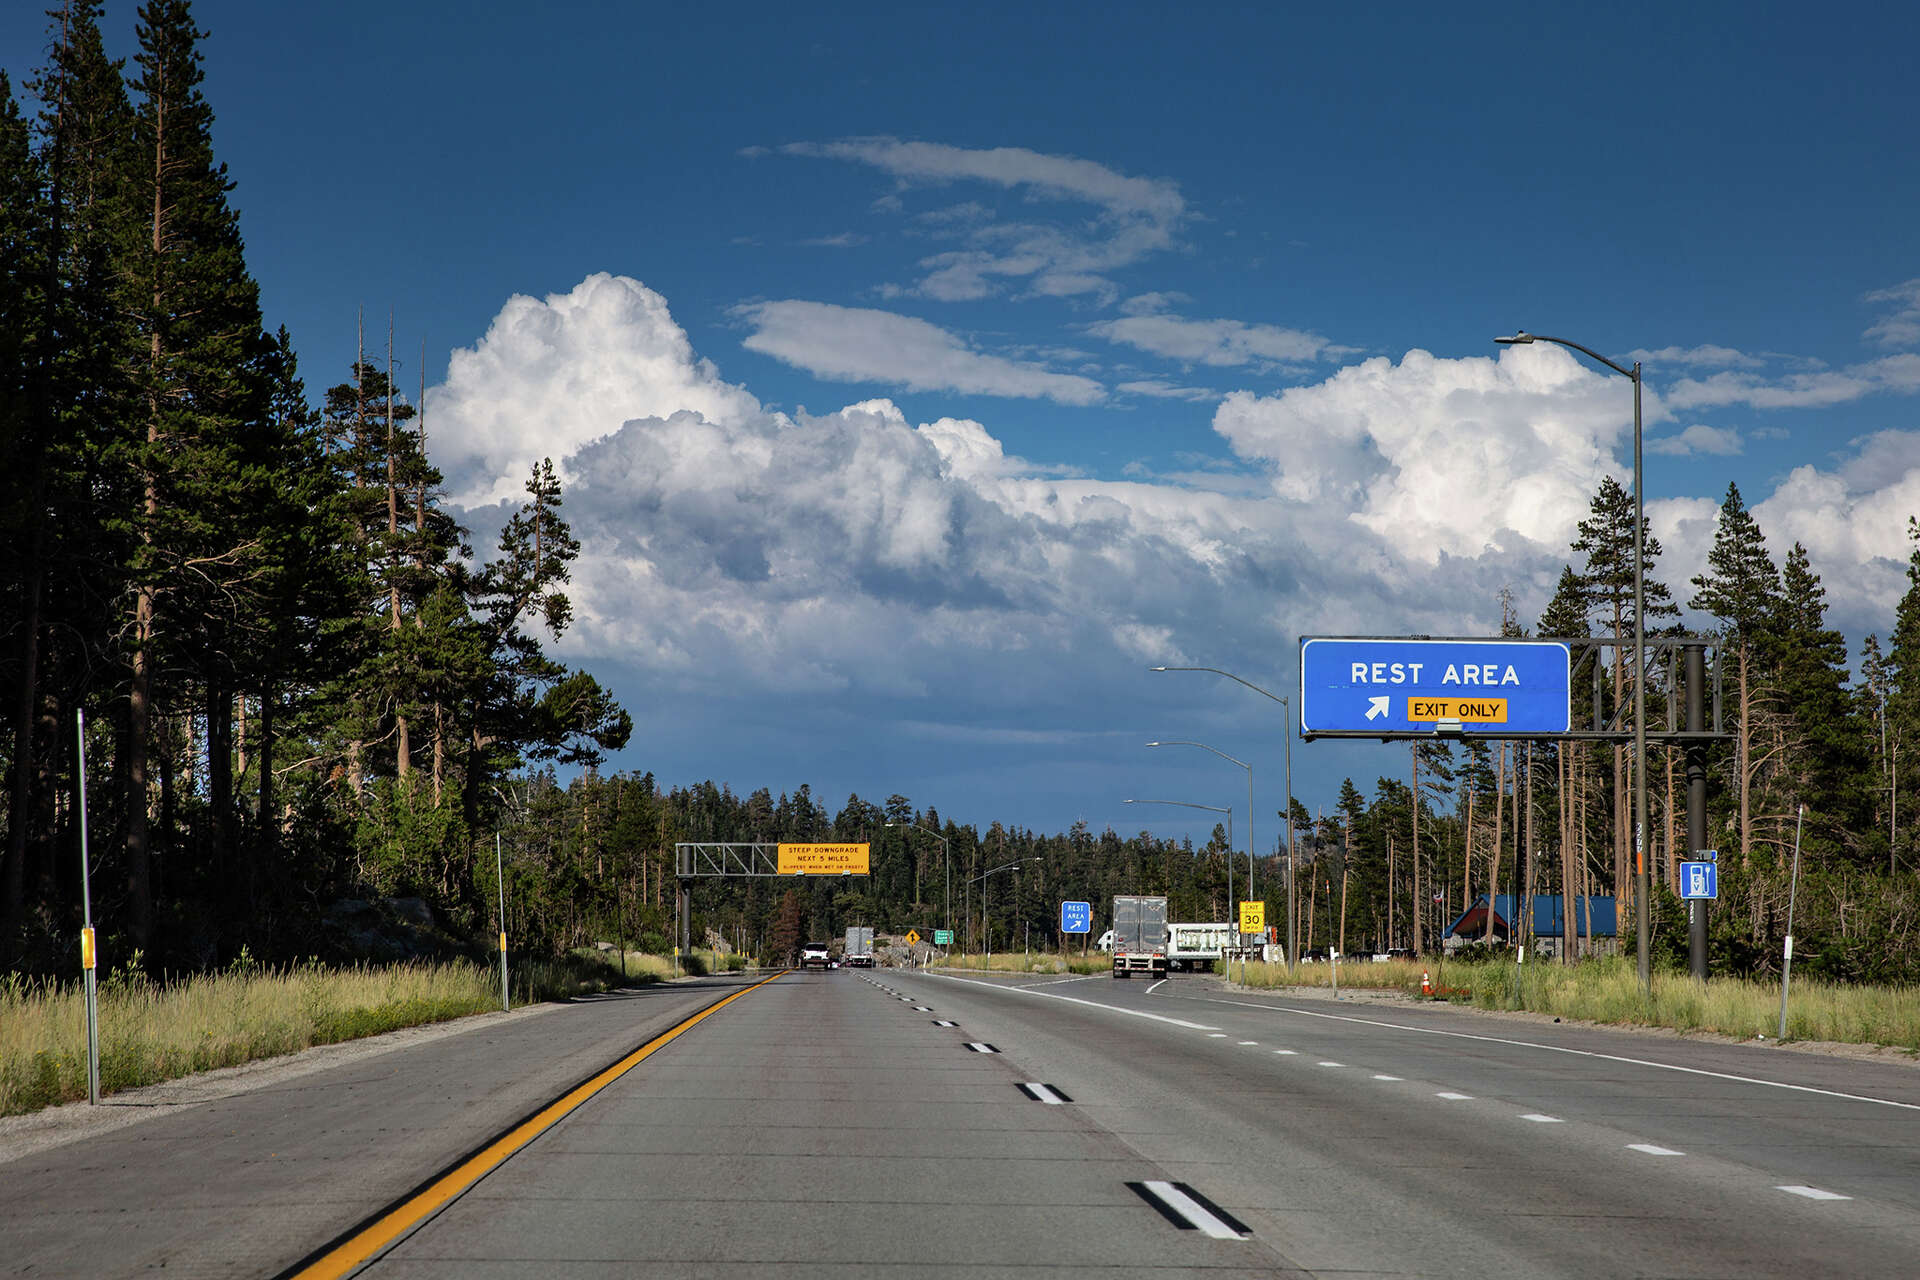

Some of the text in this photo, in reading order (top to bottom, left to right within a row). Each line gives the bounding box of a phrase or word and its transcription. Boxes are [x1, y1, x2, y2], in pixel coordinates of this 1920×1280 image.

[1351, 663, 1521, 686] REST AREA
[1414, 703, 1500, 717] EXIT ONLY
[1693, 876, 1700, 891] EV
[1245, 915, 1260, 924] 30
